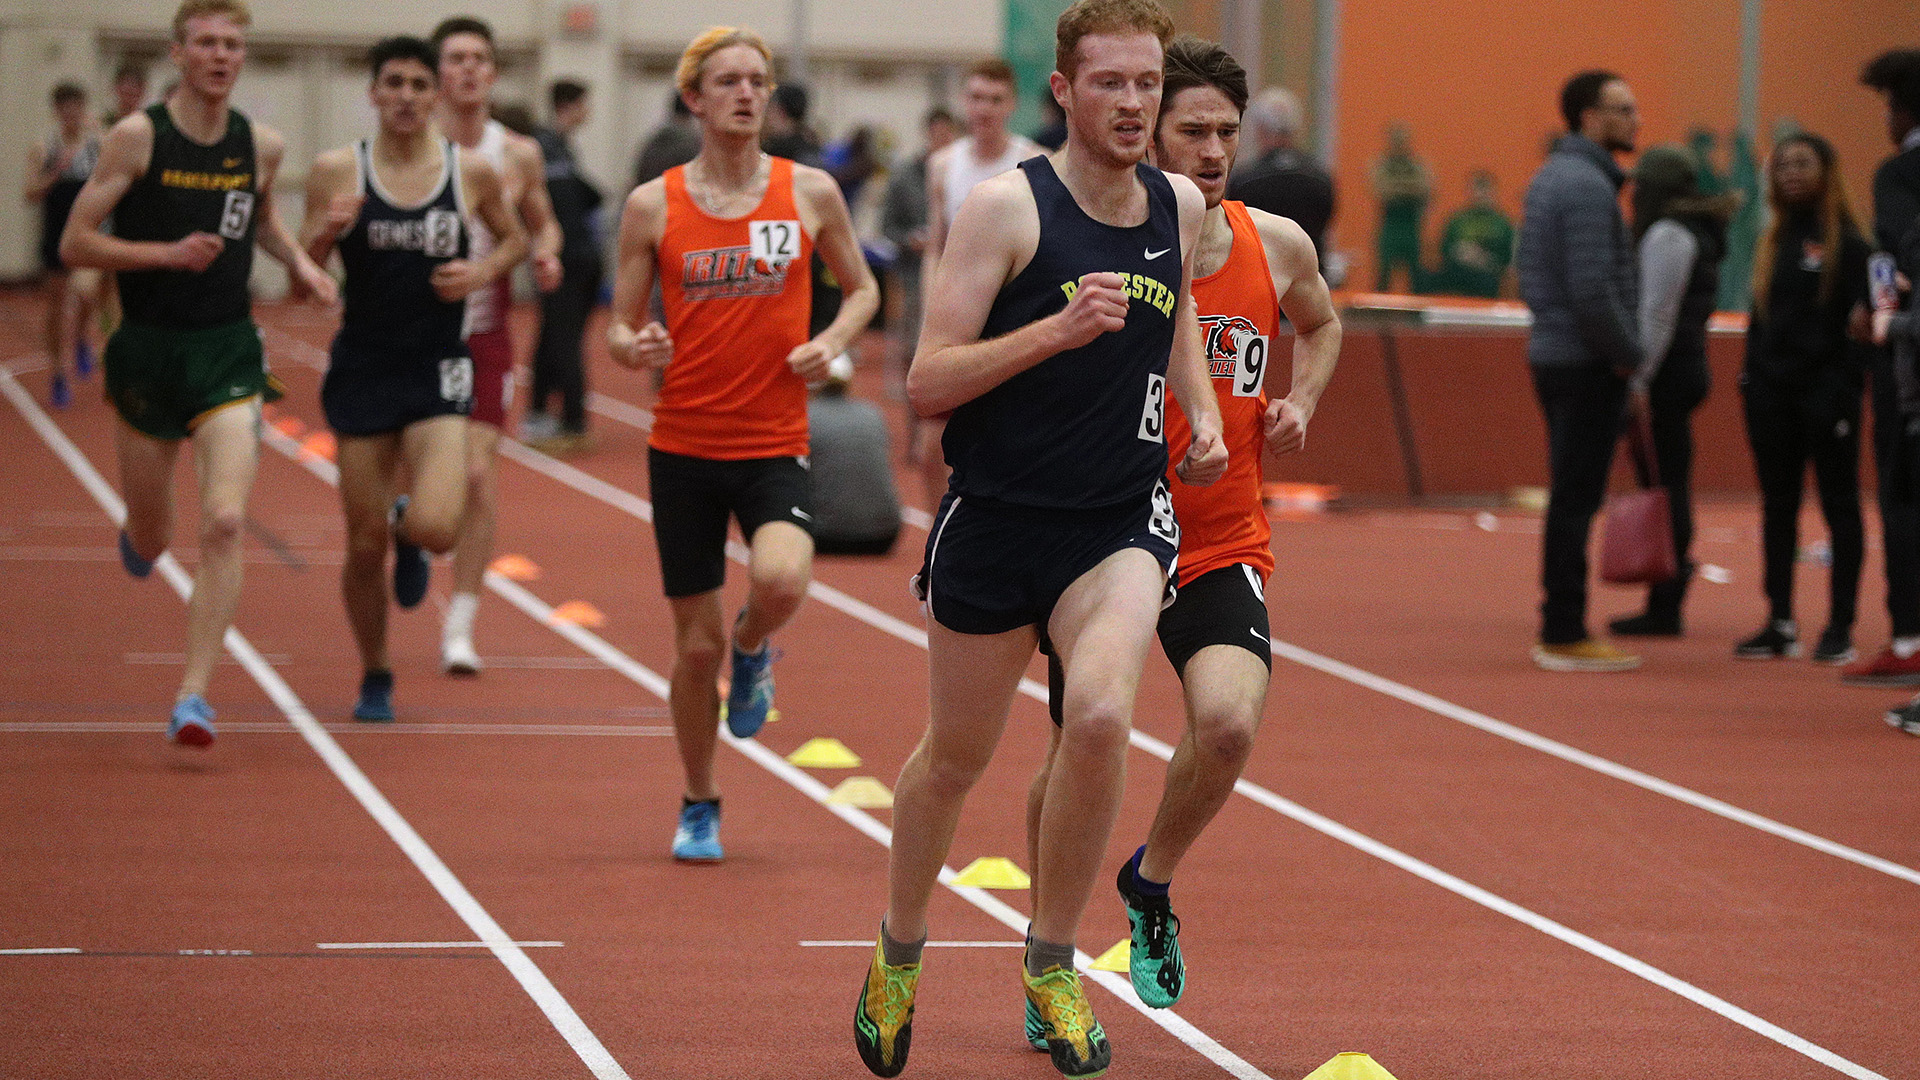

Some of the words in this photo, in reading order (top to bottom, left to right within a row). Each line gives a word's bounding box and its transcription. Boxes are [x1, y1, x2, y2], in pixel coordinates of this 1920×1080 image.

[227, 198, 247, 231] 5
[758, 223, 792, 256] 12
[685, 249, 755, 283] RIT
[1060, 271, 1175, 319] RESTER
[1208, 361, 1236, 375] IEL
[1242, 338, 1264, 394] 9
[1145, 379, 1163, 438] 3
[1153, 486, 1177, 539] 3
